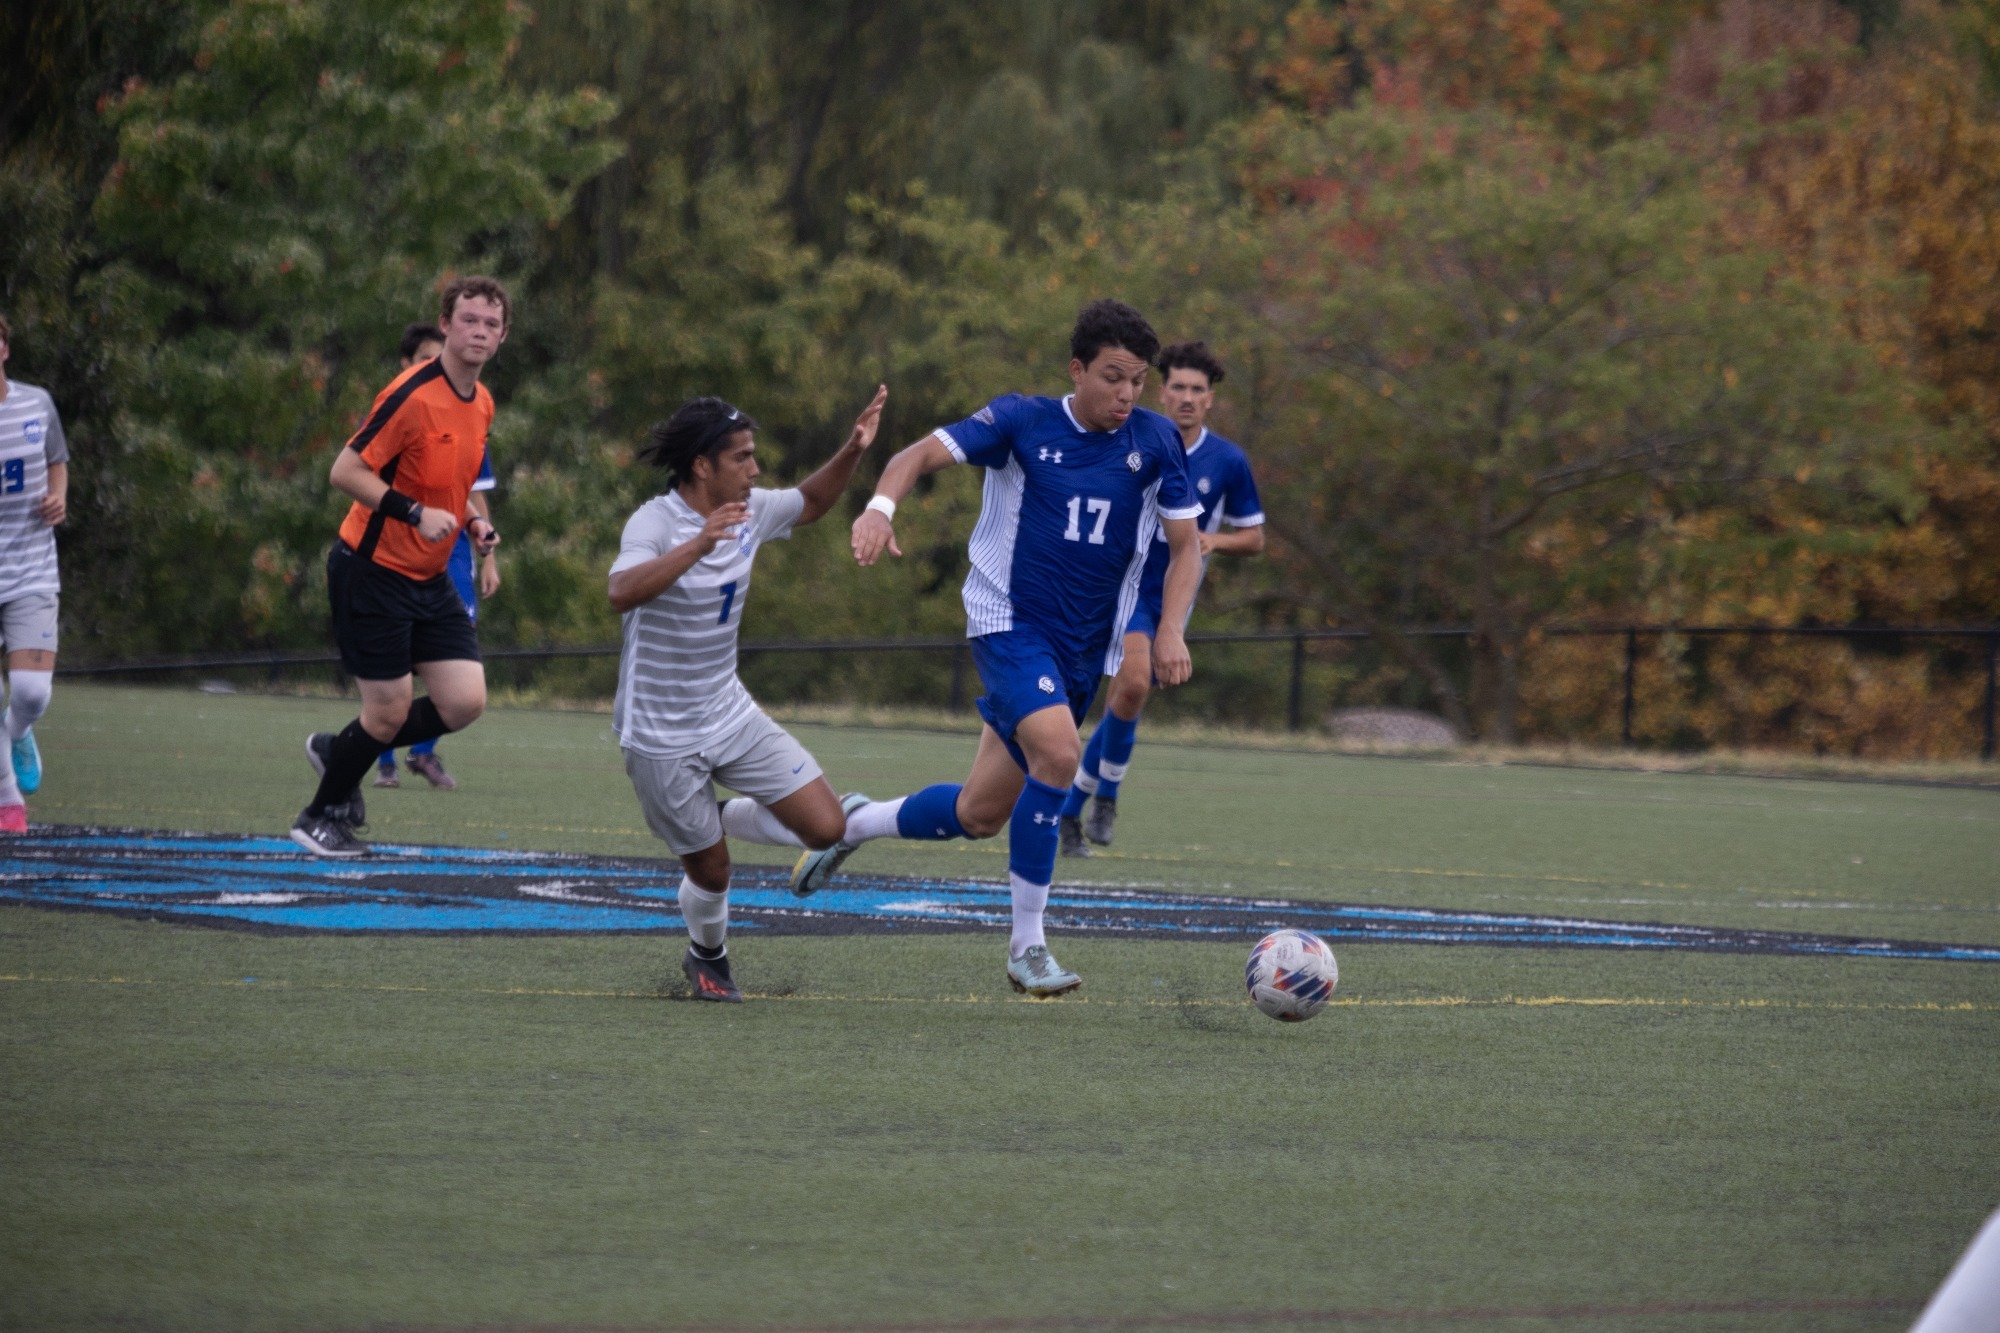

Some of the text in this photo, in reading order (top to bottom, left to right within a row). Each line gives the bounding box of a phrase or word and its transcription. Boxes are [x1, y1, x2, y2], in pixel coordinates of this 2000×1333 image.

[0, 458, 24, 495] 9
[1064, 496, 1112, 545] 17
[717, 580, 738, 625] 7
